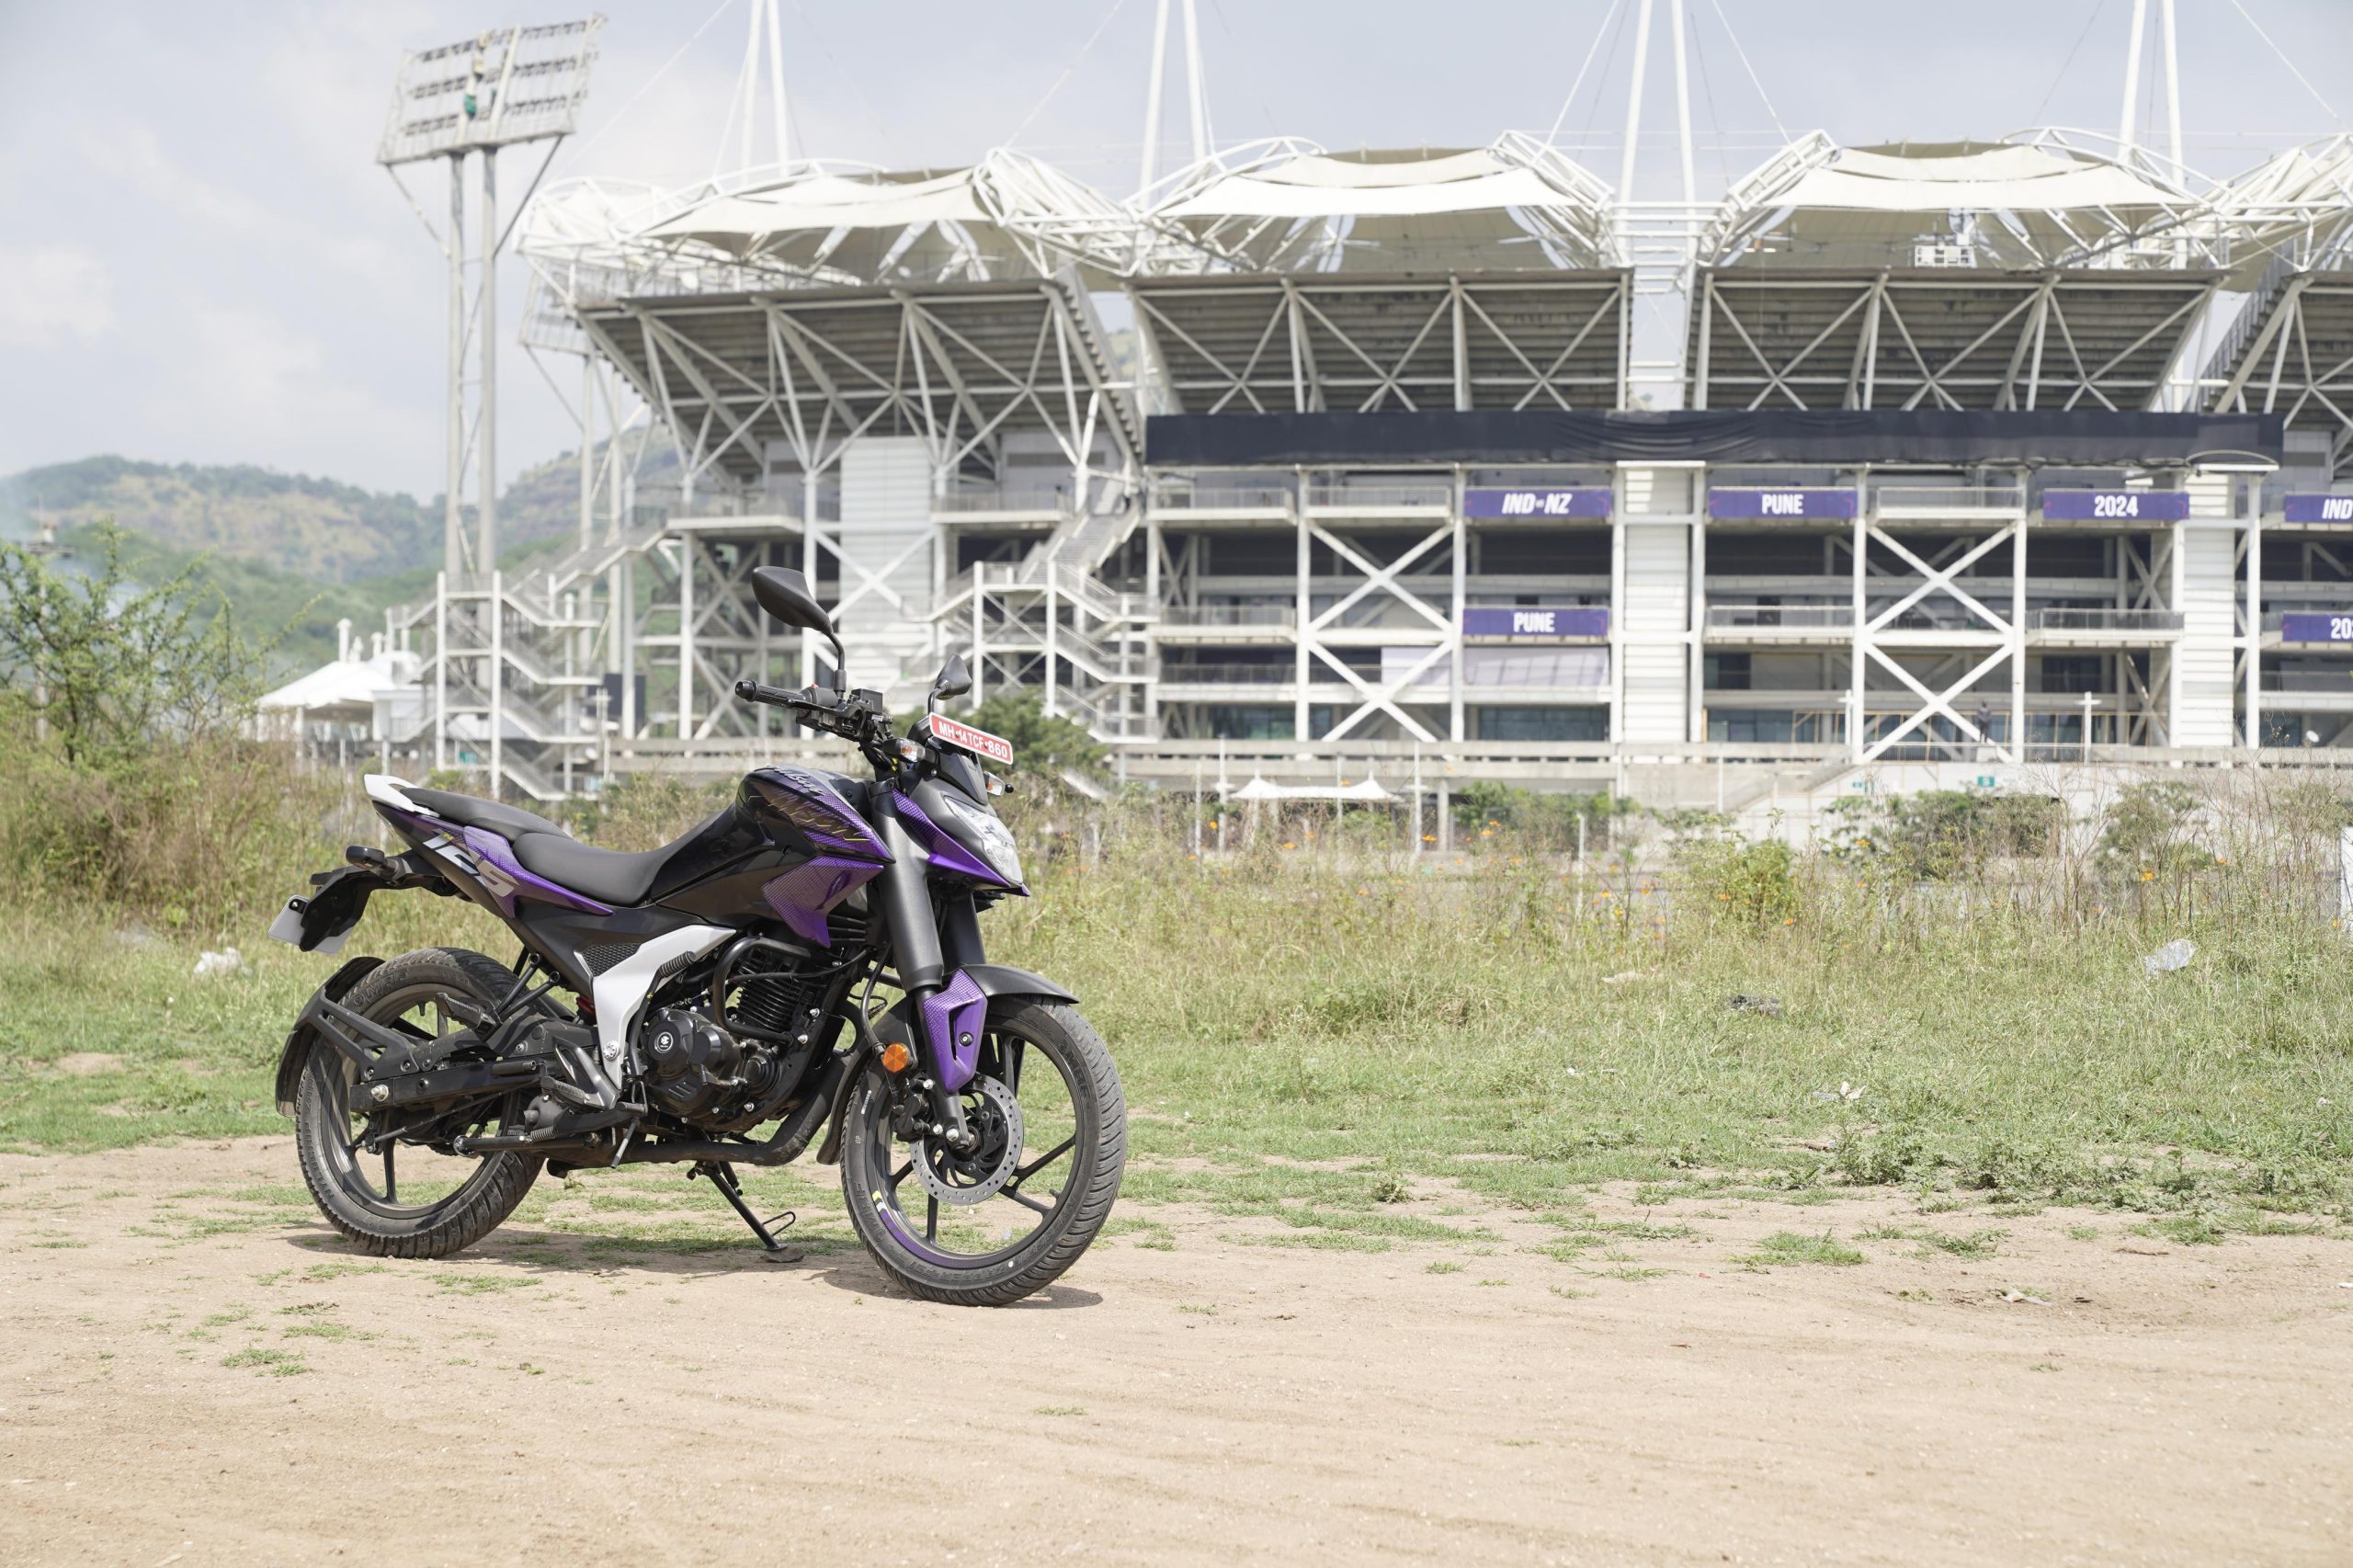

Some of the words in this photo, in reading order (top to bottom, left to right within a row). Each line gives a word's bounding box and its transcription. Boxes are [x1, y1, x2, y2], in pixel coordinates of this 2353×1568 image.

[1761, 494, 1804, 515] PUNE
[2094, 494, 2139, 517] 2024
[2322, 498, 2353, 519] IND
[1513, 611, 1555, 633] PUNE
[2331, 617, 2353, 640] 20
